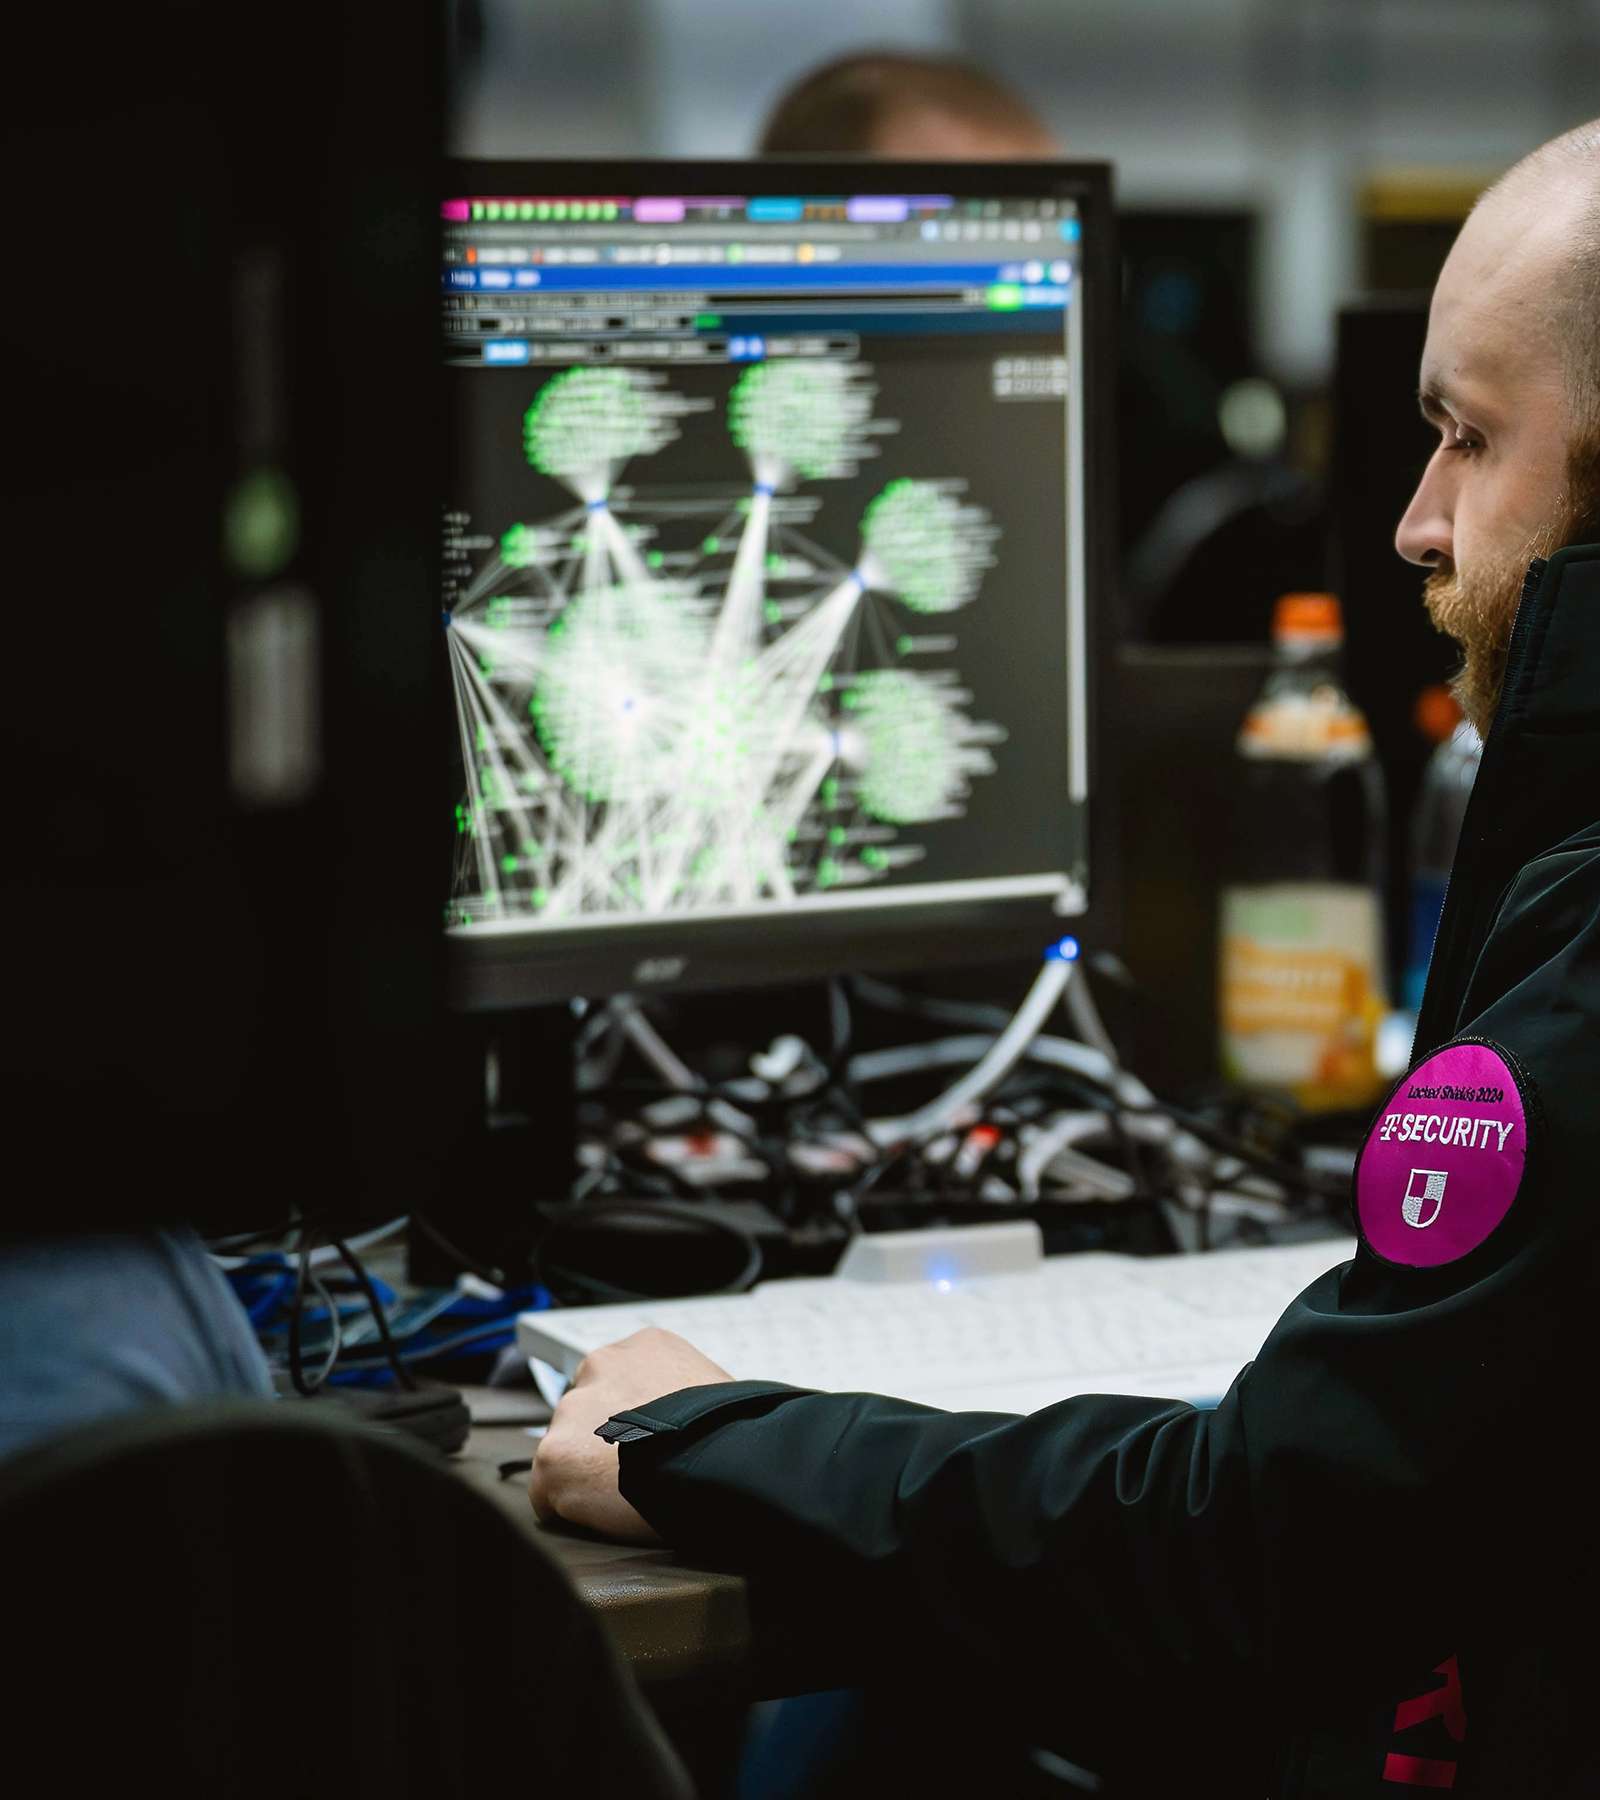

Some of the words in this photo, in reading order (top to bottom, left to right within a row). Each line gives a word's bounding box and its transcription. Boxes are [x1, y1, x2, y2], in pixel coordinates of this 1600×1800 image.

[1408, 1085, 1440, 1099] Locked
[1440, 1085, 1476, 1102] Shields
[1476, 1087, 1504, 1103] 2024
[1398, 1114, 1514, 1151] SECURITY
